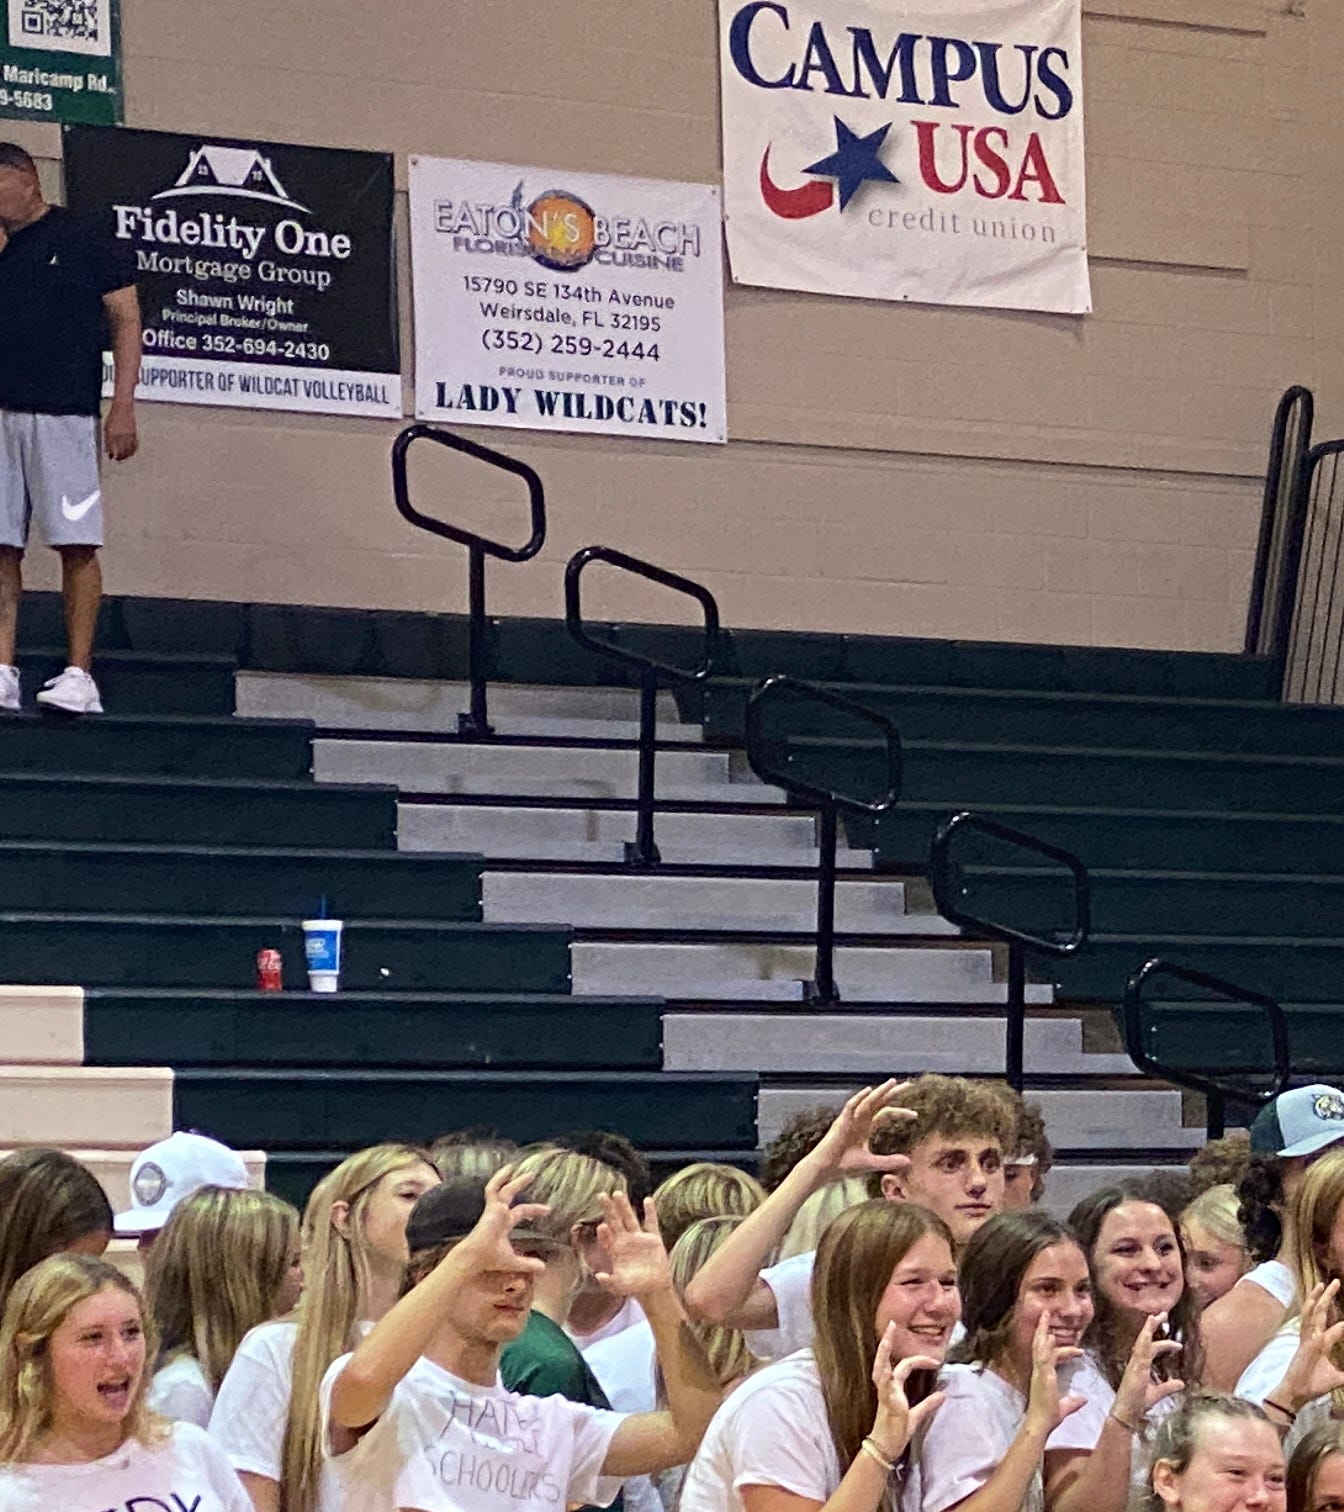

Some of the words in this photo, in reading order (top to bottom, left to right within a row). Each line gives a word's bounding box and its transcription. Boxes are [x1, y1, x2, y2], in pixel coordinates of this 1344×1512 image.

[729, 1, 1073, 120] CAMPUS
[3, 65, 83, 92] Maricamp
[910, 121, 1065, 204] USA
[112, 205, 265, 259] Fidelity
[275, 220, 351, 258] One
[434, 199, 581, 244] EATON'S
[593, 216, 700, 258] BEACH
[868, 206, 960, 234] credit
[973, 217, 1055, 243] union
[136, 250, 251, 282] Mortgage
[258, 260, 331, 291] Group
[593, 251, 684, 272] CUISINE
[176, 289, 233, 310] Shawn
[238, 294, 294, 316] Wright
[463, 275, 517, 295] 15790
[524, 281, 547, 297] SE
[554, 283, 601, 302] 134th
[608, 289, 675, 309] Avenue
[162, 309, 217, 326] Principal
[479, 301, 577, 327] Weirsdale,
[583, 311, 604, 328] FL
[611, 313, 661, 331] 32195
[142, 329, 197, 350] Office
[202, 334, 330, 360] 352-694-2430
[482, 329, 542, 353] (352)
[551, 335, 661, 362] 259-2444
[138, 367, 214, 391] UPPORTER
[218, 373, 235, 391] OF
[239, 375, 298, 397] WILDCAT
[303, 379, 390, 404] VOLLEYBALL
[499, 366, 544, 381] PROUD
[549, 370, 624, 387] SUPPORTER
[629, 377, 646, 387] OF
[435, 381, 521, 414] LADY
[535, 389, 707, 428] WILDCATS!
